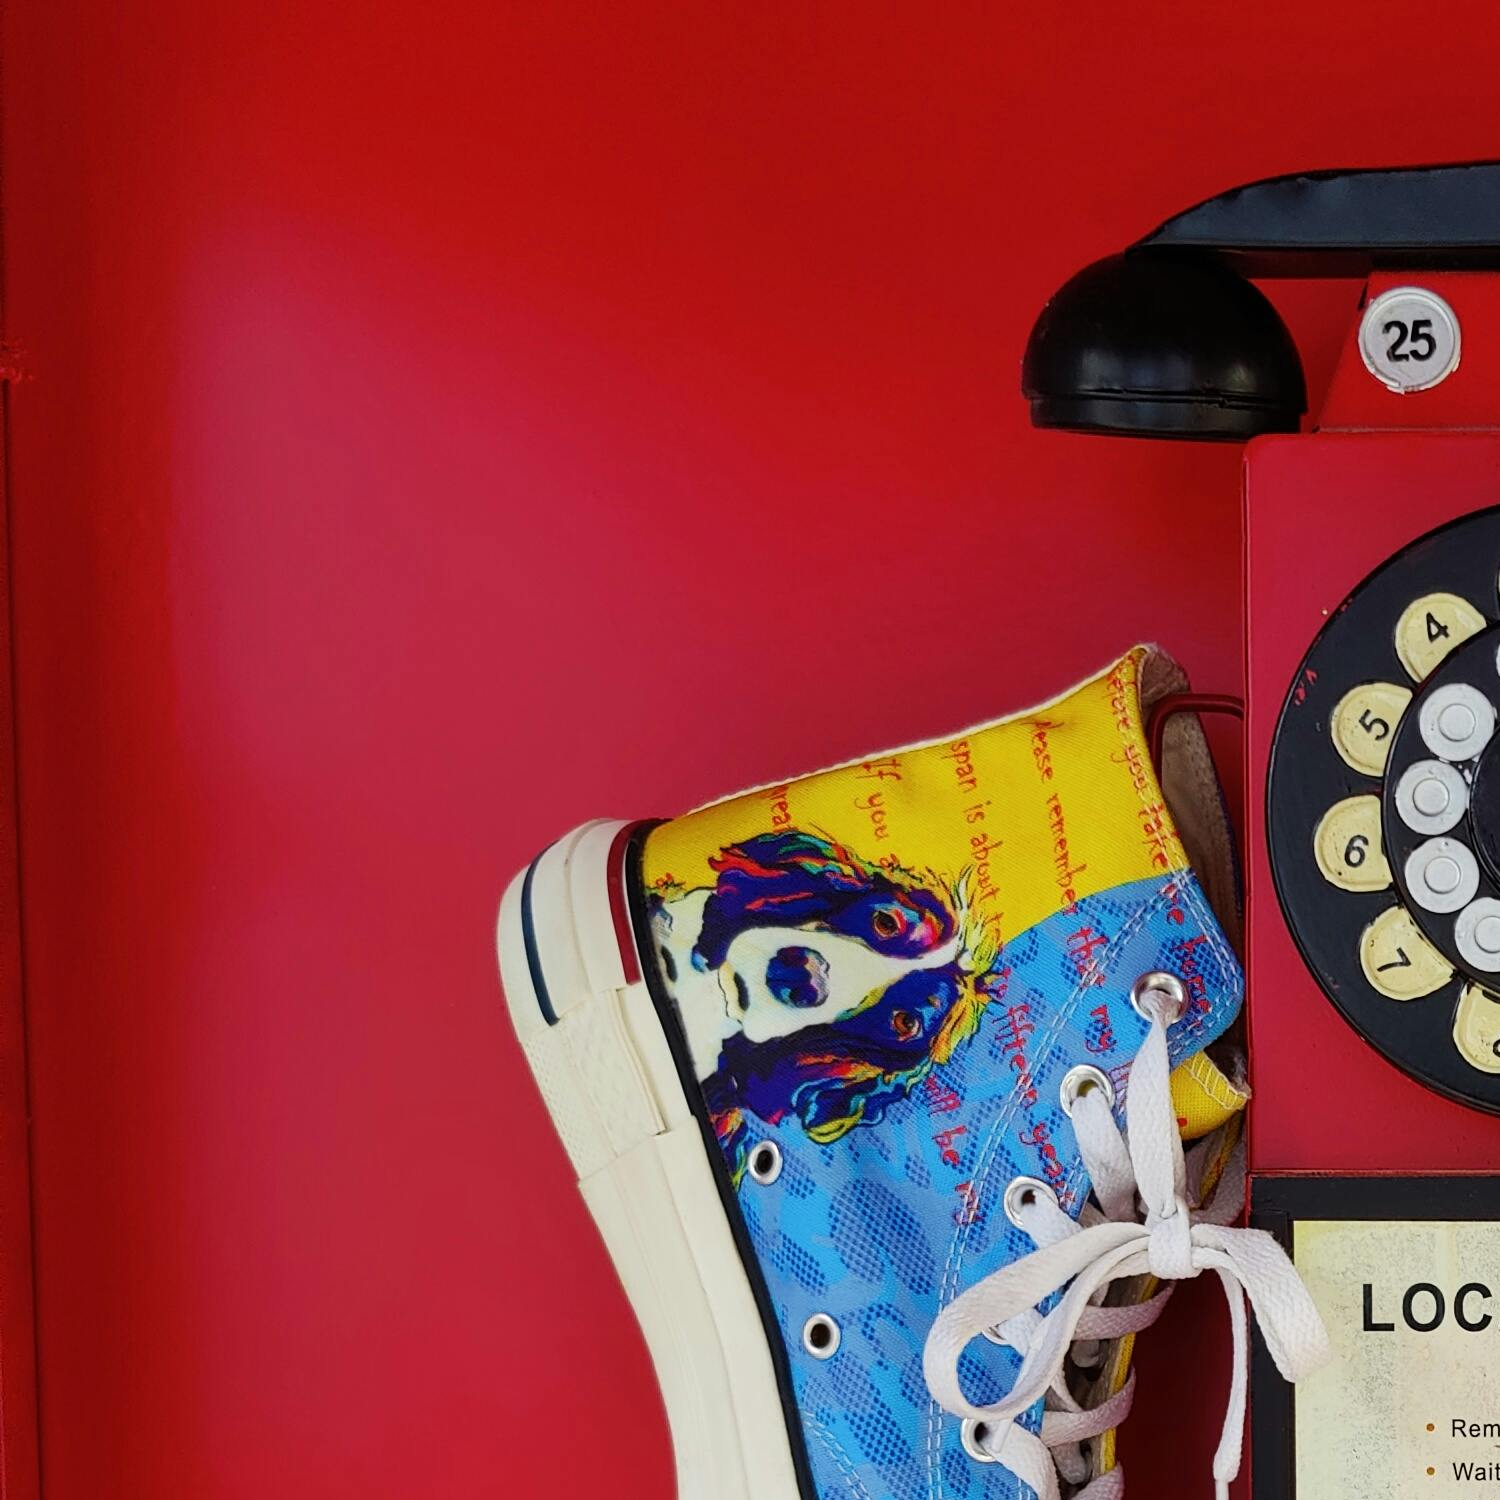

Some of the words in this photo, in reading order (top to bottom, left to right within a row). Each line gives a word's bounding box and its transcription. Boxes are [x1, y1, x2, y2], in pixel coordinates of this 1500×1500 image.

[1383, 320, 1436, 361] 25
[1426, 613, 1449, 642] 4
[1359, 709, 1389, 740] 5
[941, 740, 979, 793] span
[963, 800, 992, 826] is
[1345, 835, 1368, 867] 6
[970, 833, 1004, 904] about
[1377, 948, 1411, 972] 7
[854, 791, 890, 842] you
[932, 1125, 968, 1166] be
[1085, 1004, 1117, 1054] my
[1453, 1463, 1500, 1481] Wait
